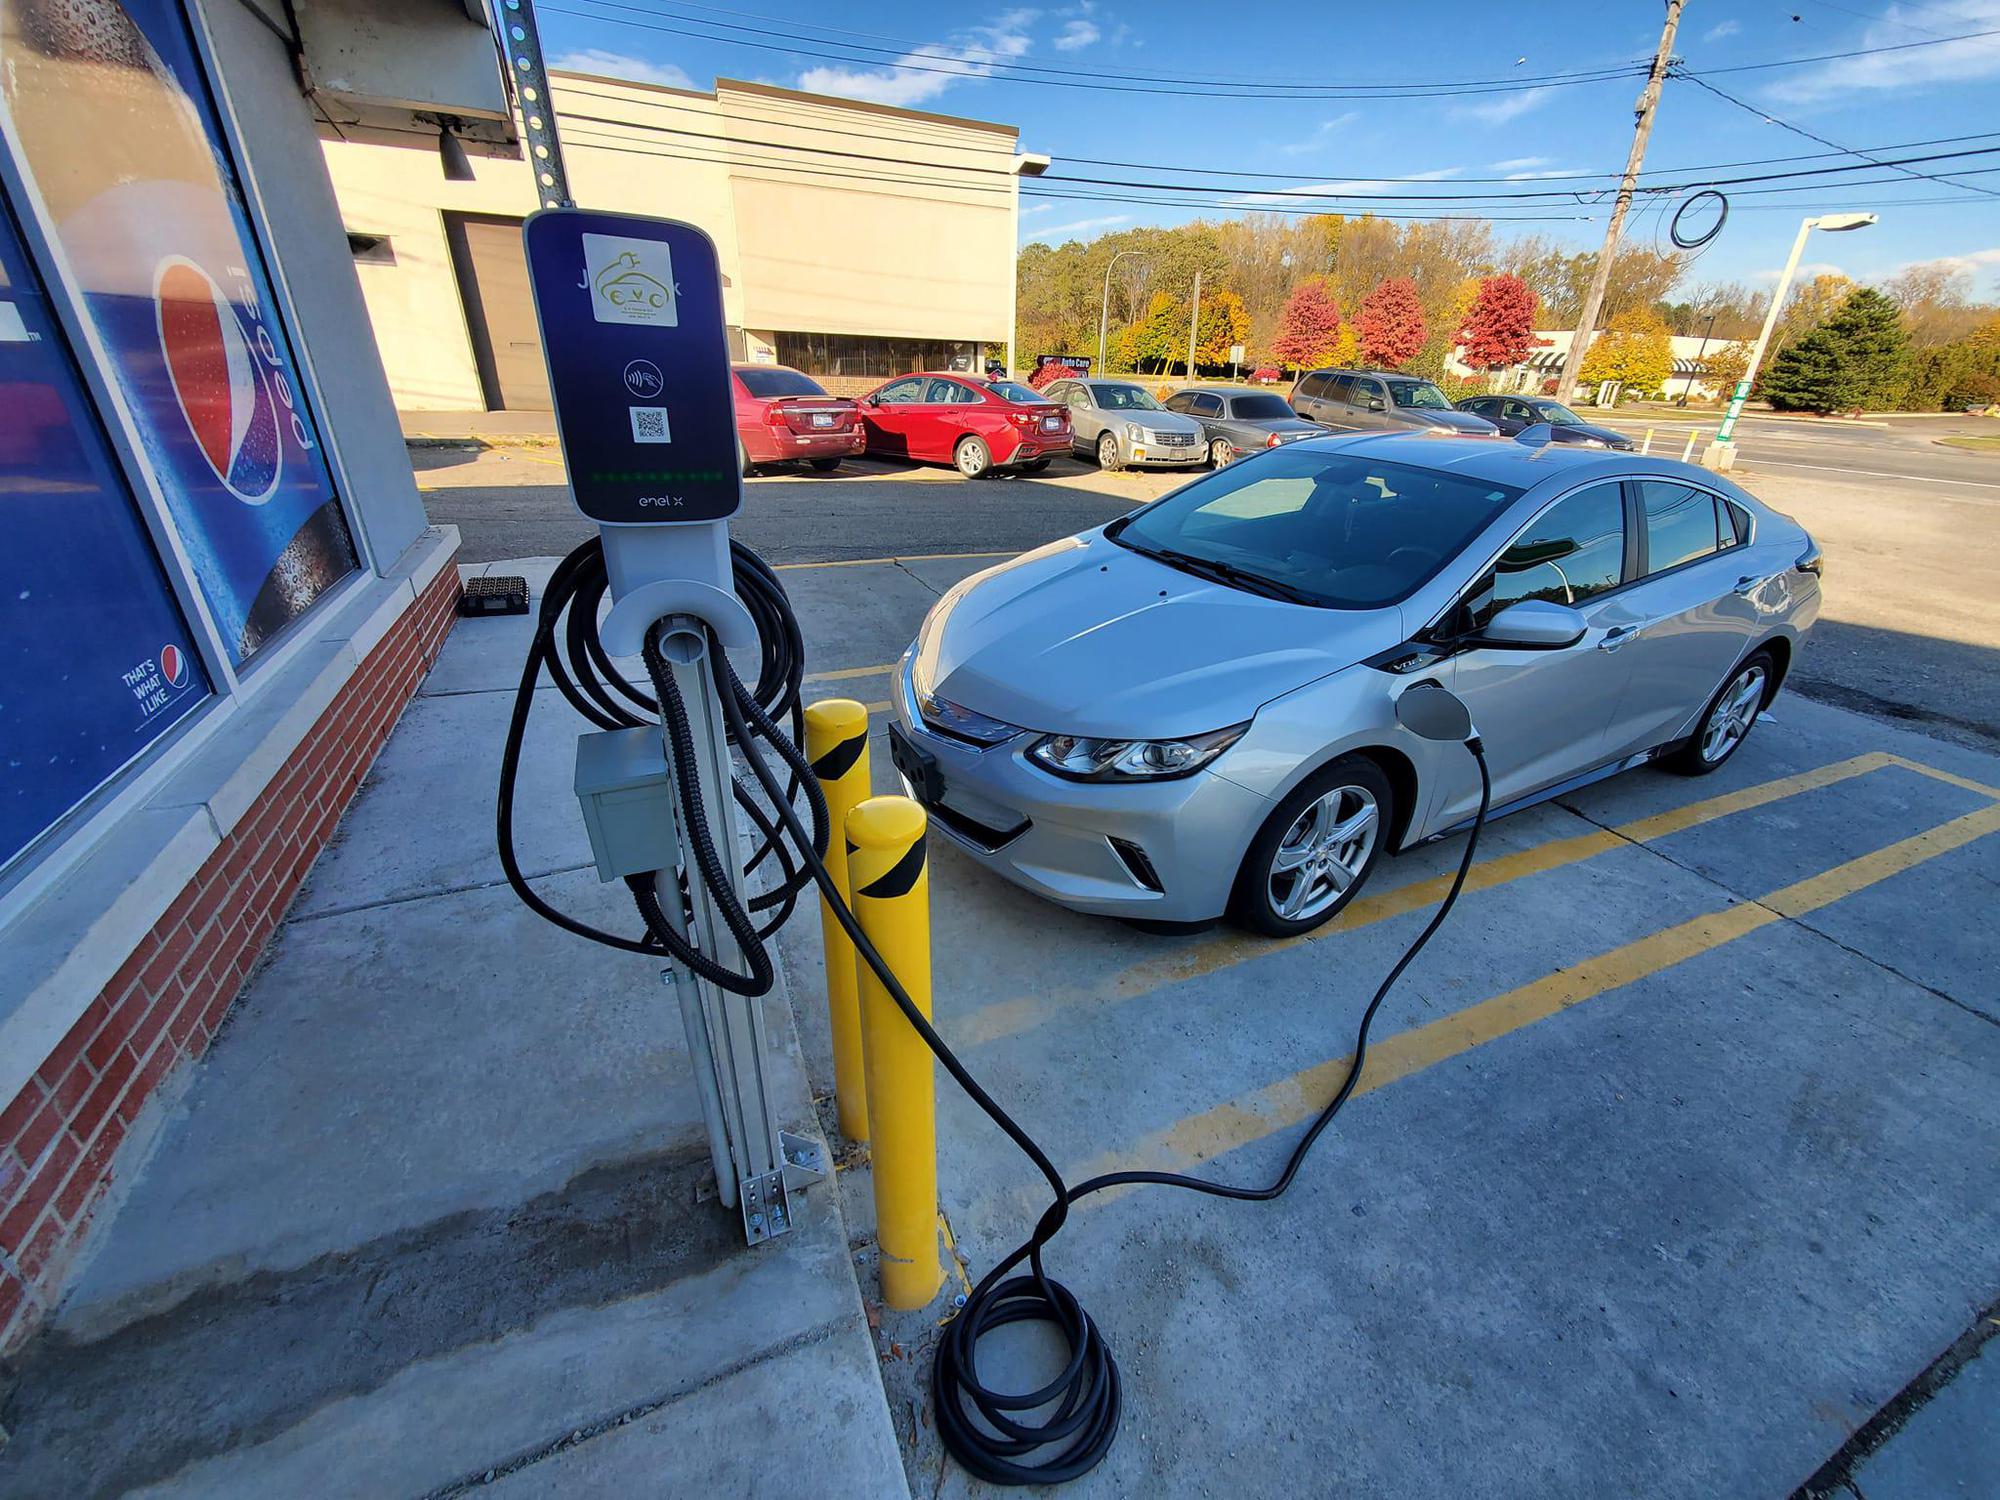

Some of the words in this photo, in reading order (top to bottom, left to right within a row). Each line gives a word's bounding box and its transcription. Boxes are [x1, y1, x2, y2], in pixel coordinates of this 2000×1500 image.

[226, 264, 315, 450] pepsi
[1075, 358, 1090, 368] Care
[639, 495, 671, 507] enel
[121, 658, 156, 688] THAT'S
[132, 673, 162, 700] WHAT
[140, 703, 148, 717] I
